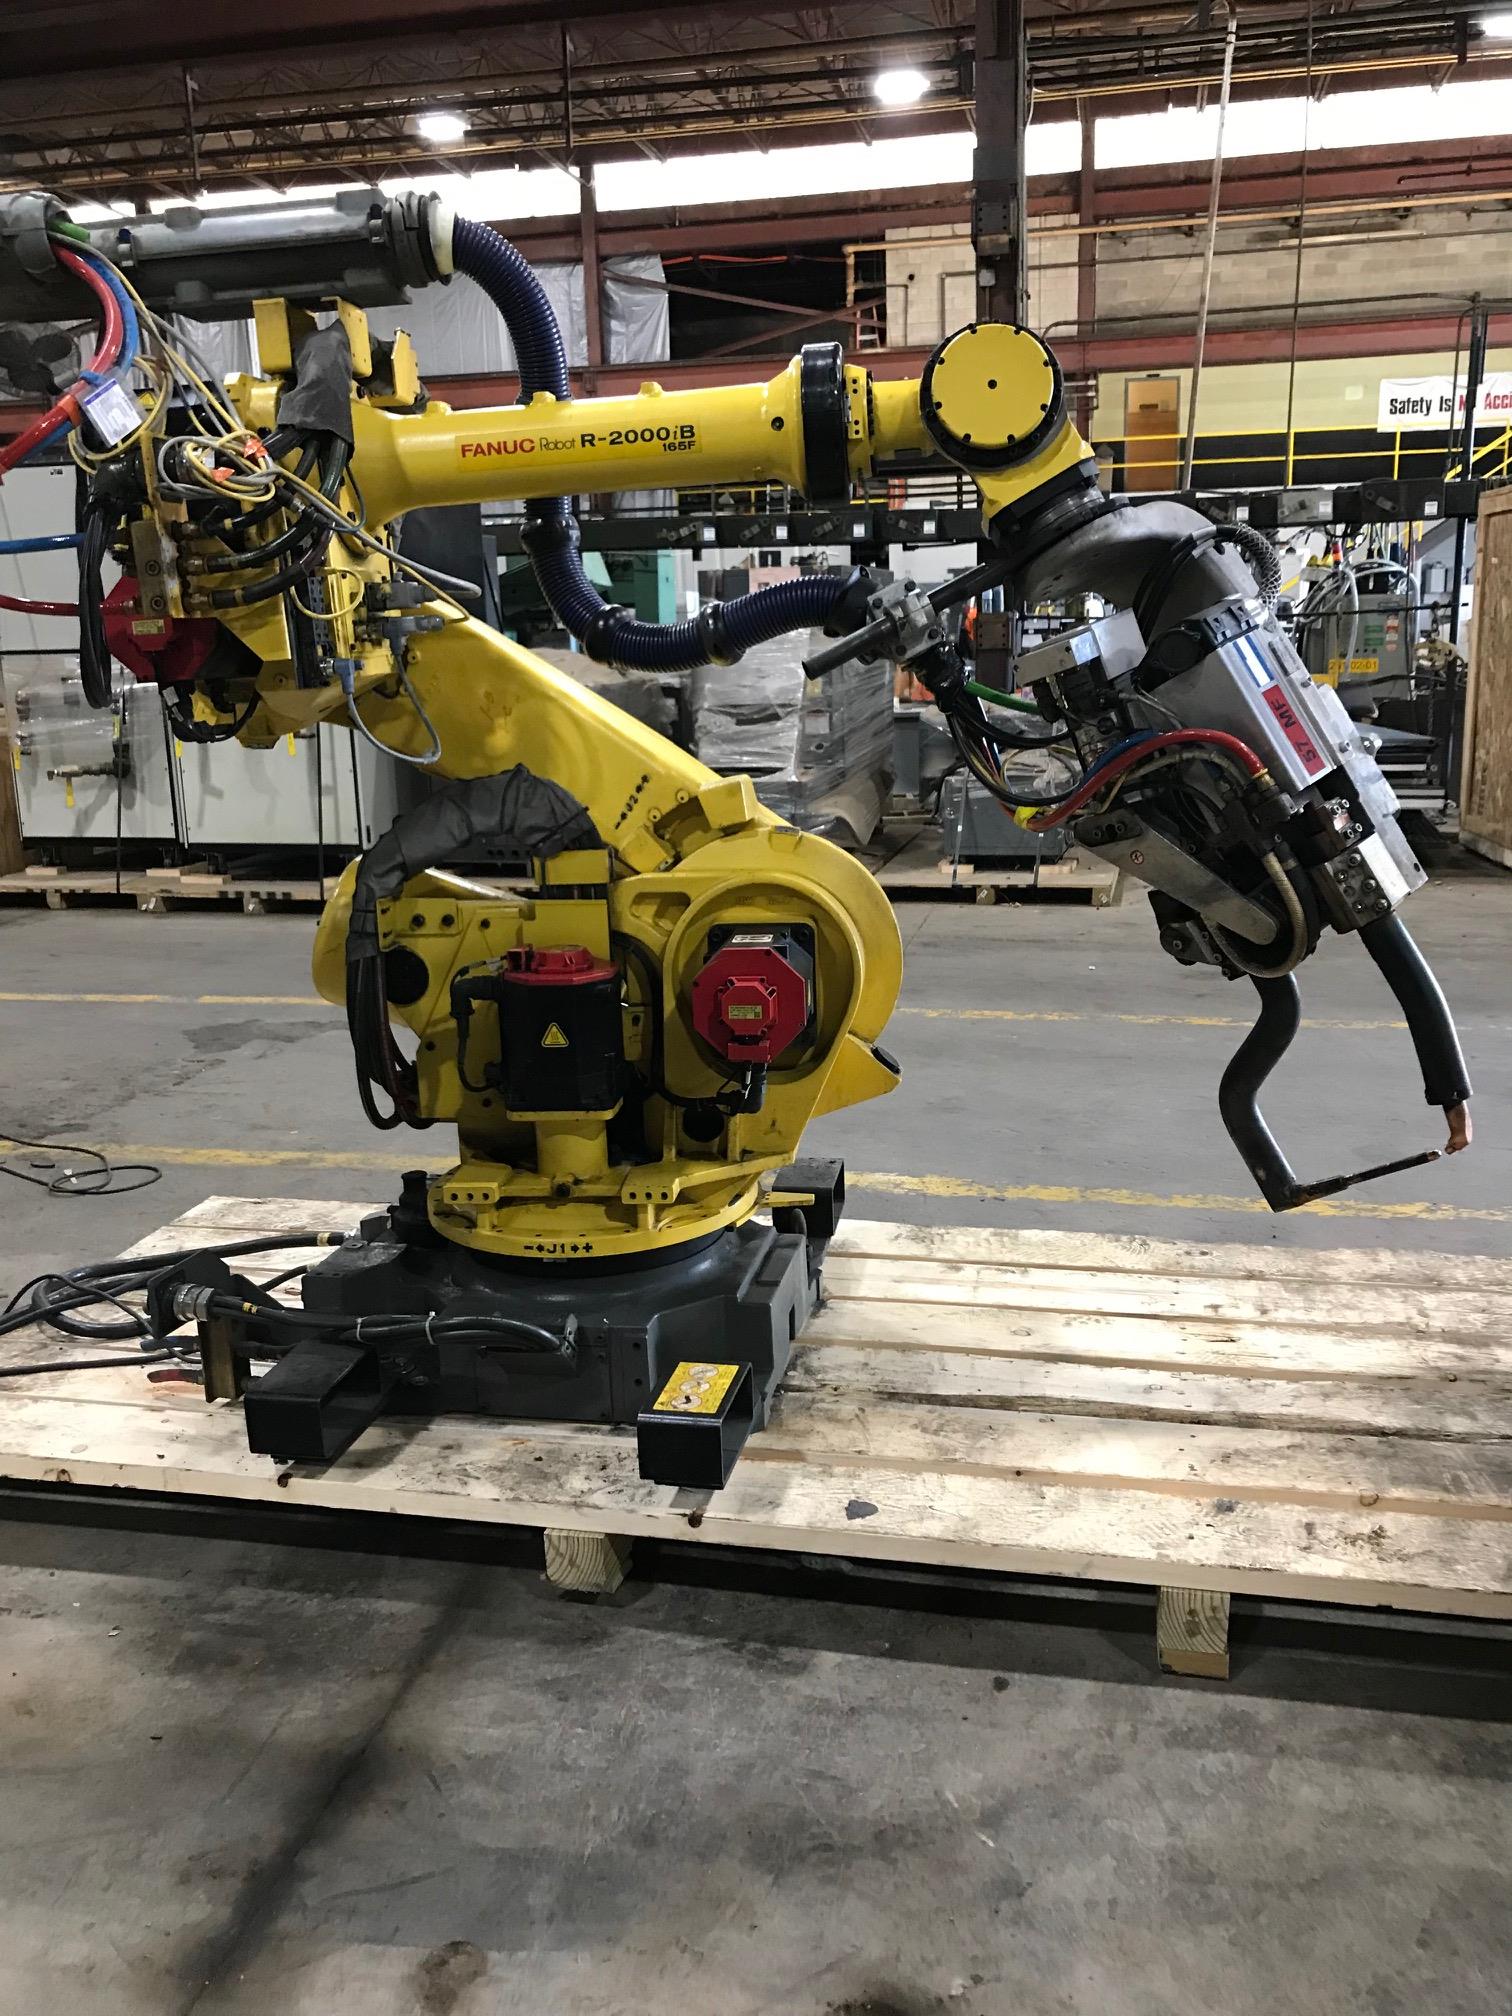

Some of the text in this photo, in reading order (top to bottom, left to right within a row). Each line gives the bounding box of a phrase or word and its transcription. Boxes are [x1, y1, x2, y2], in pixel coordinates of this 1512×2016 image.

[1389, 397, 1432, 416] Safety
[1438, 395, 1452, 412] Is
[461, 424, 696, 458] FANUC Robot R-2000iB
[662, 440, 697, 452] 165F
[1271, 695, 1317, 763] 57 MF
